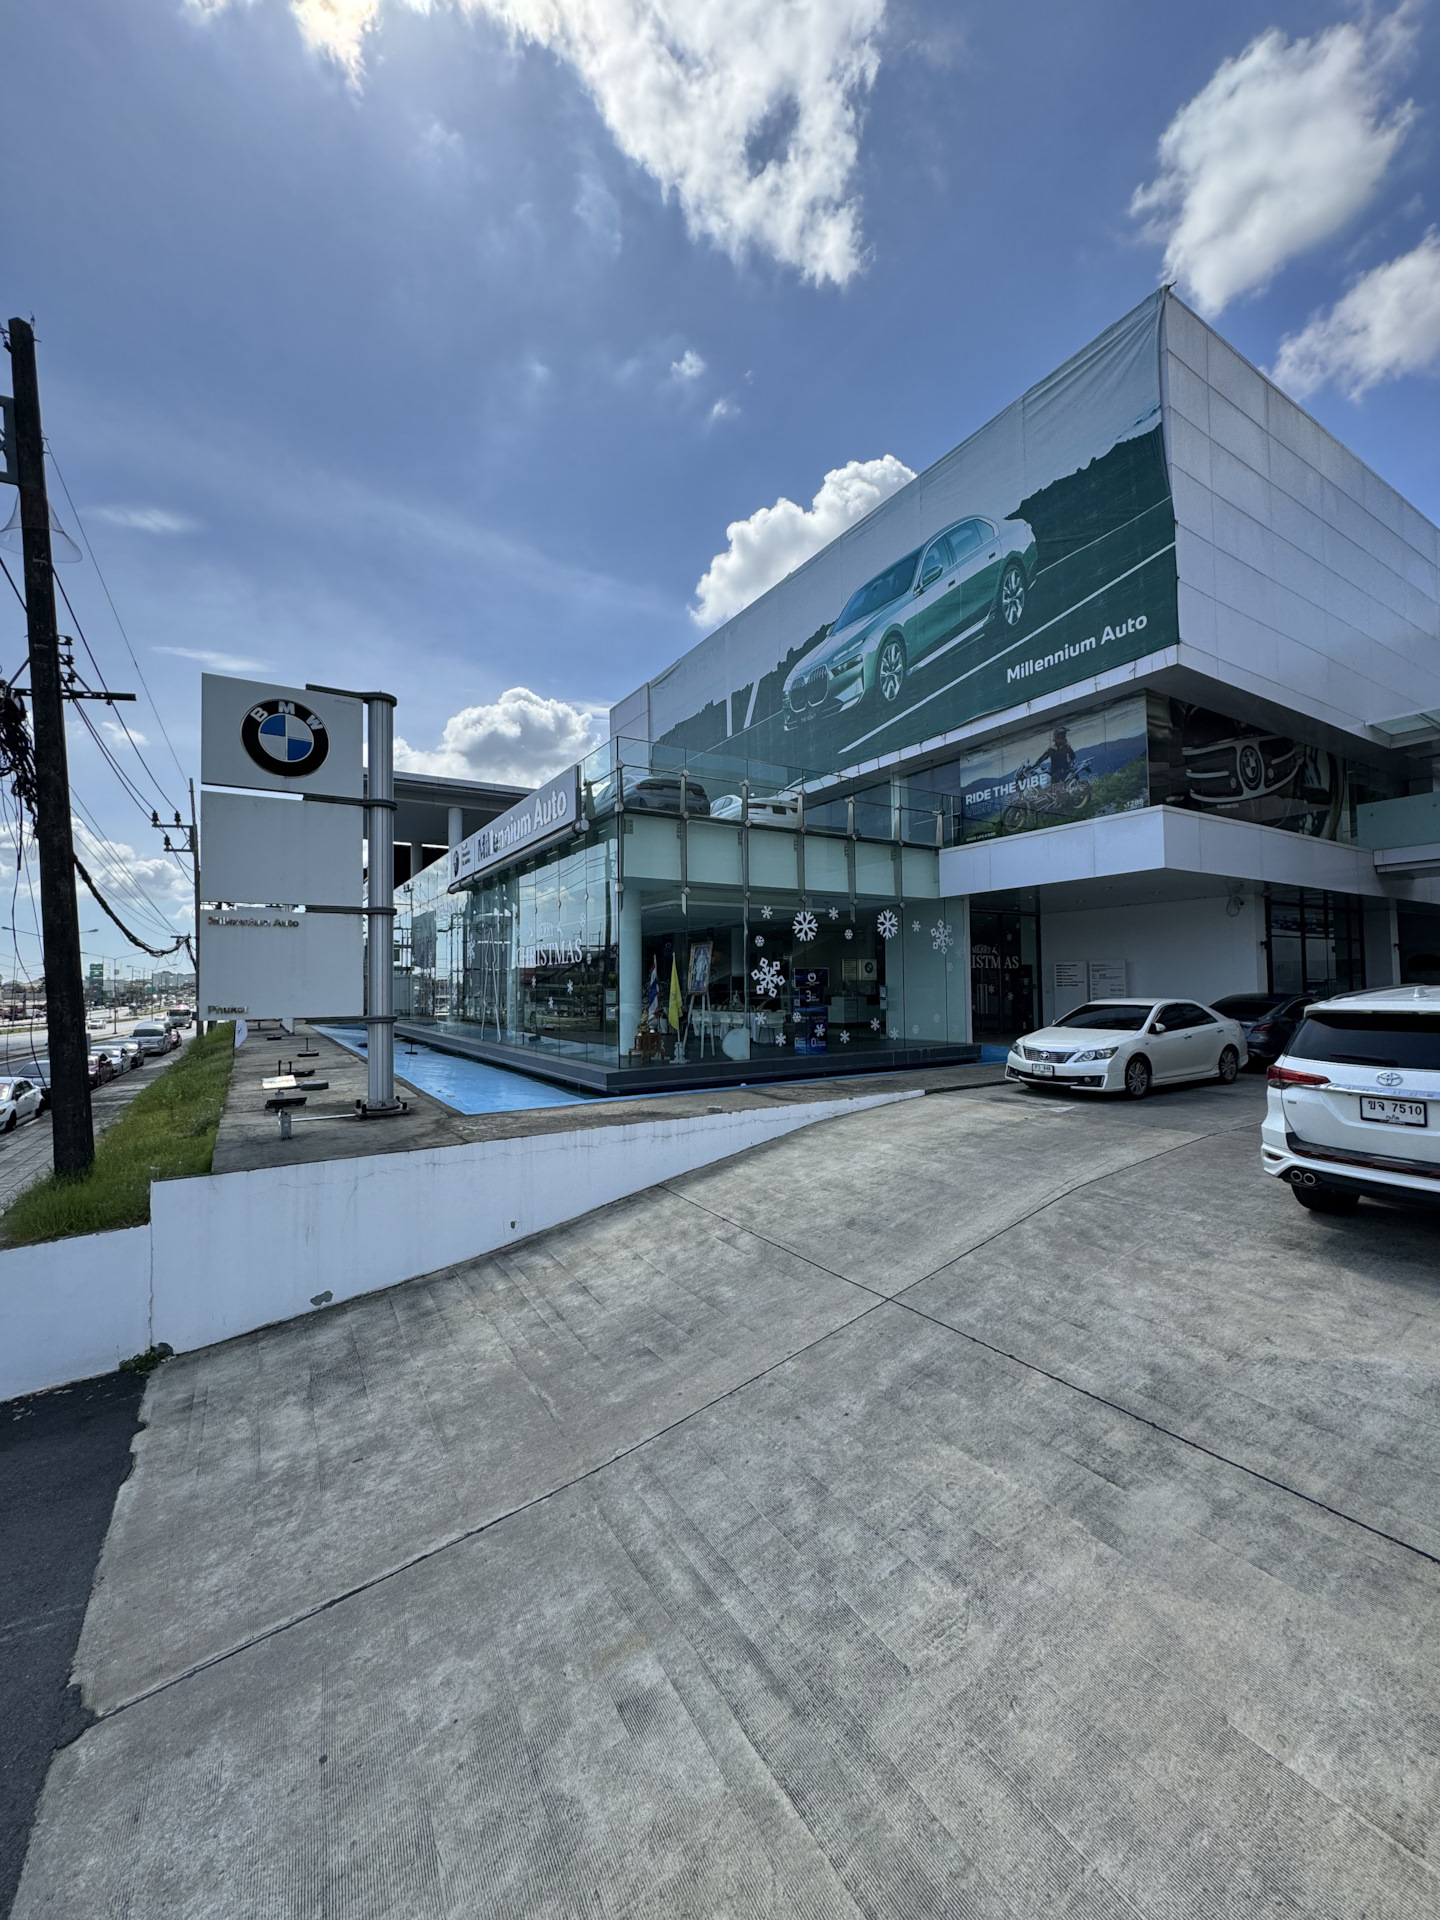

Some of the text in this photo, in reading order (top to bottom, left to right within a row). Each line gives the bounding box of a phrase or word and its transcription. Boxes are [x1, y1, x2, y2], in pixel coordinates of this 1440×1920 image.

[1006, 615, 1148, 684] Millennium Auto
[250, 701, 324, 731] BMW
[965, 789, 992, 806] RIDE
[992, 781, 1017, 798] THE
[1018, 773, 1049, 792] VIBE
[477, 812, 532, 863] Millennium
[533, 790, 567, 832] Auto
[272, 918, 299, 928] Auto
[1391, 1102, 1422, 1116] 7510
